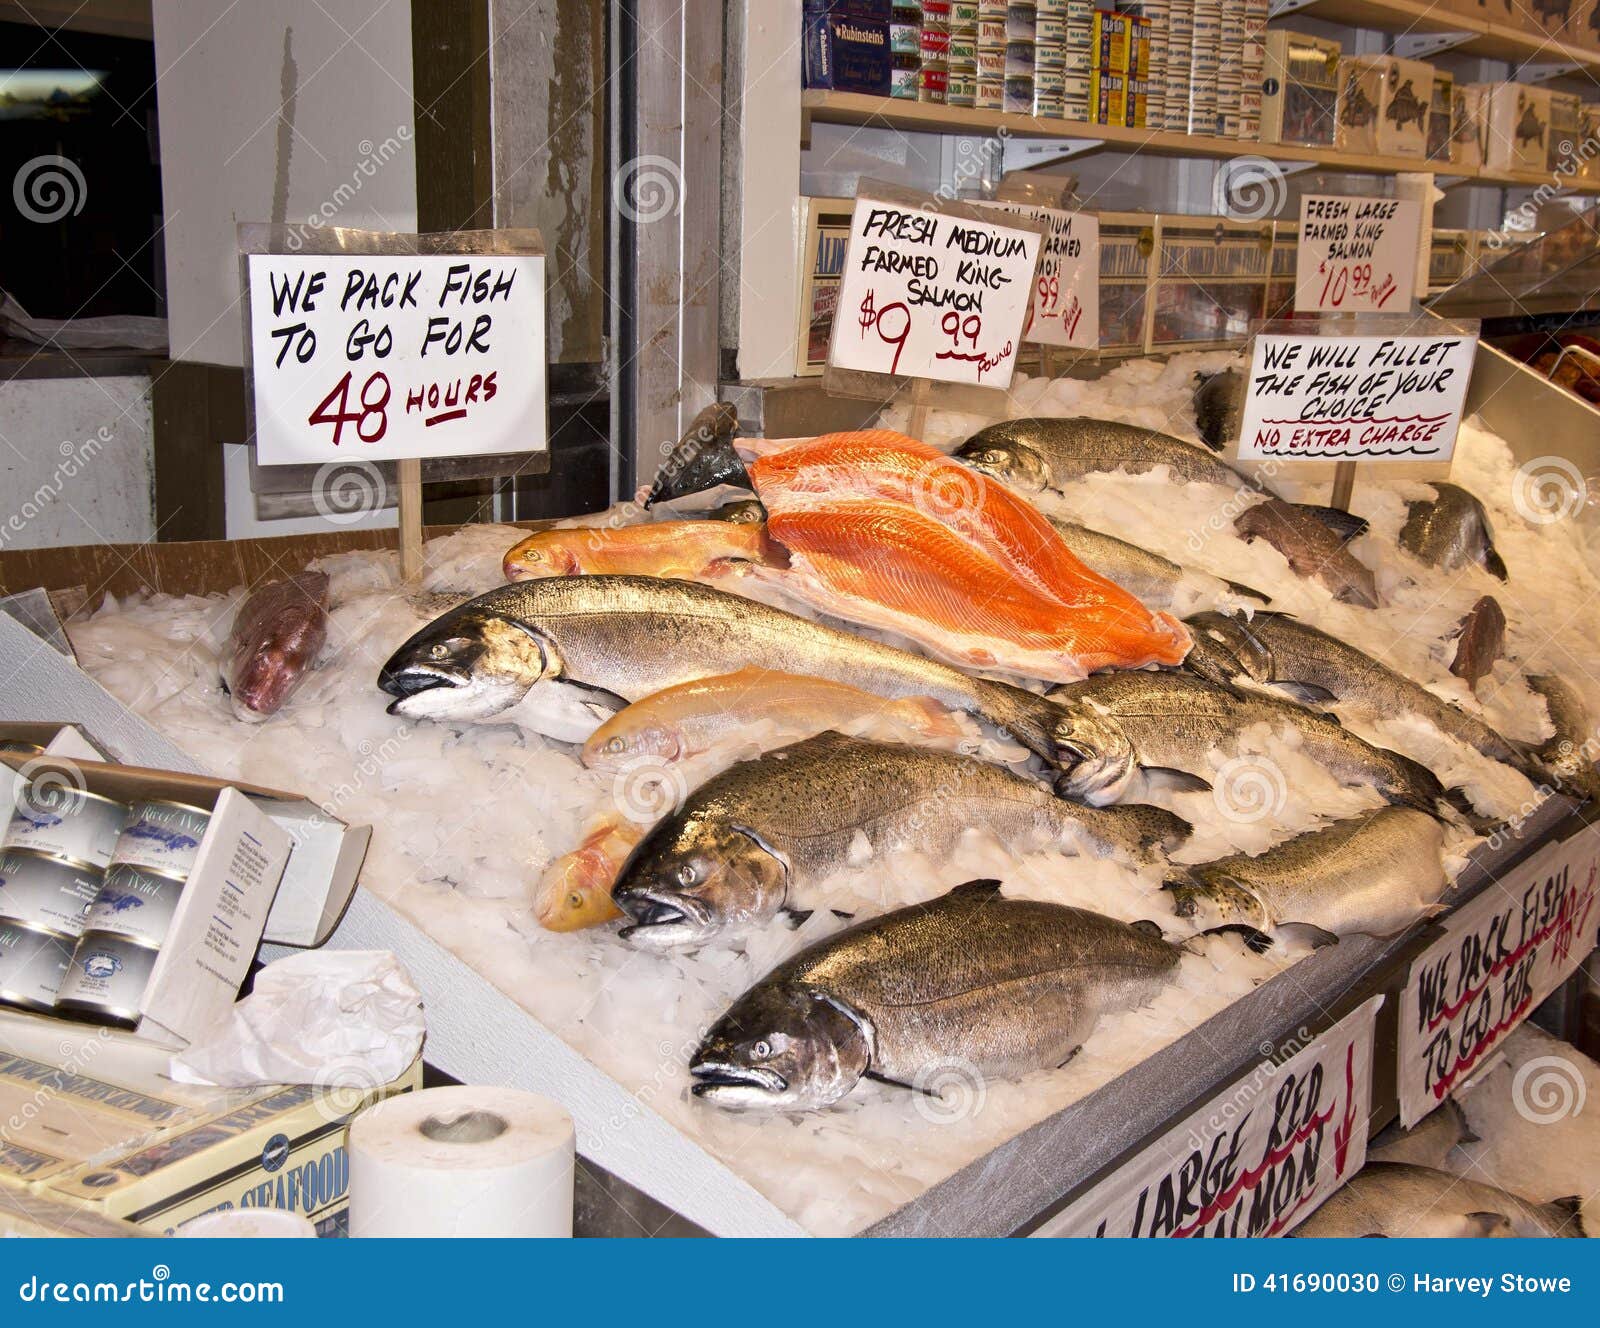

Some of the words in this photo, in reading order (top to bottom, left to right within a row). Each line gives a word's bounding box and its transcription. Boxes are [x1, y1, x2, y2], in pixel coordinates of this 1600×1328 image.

[1306, 199, 1351, 220] FRESH
[1355, 200, 1399, 220] LARGE
[863, 210, 937, 248] FRESH
[947, 225, 1027, 260] MEDIUM
[1304, 223, 1349, 242] FARMED
[1354, 221, 1385, 243] KING
[862, 246, 938, 280] FARMED
[1327, 242, 1375, 260] SALMON
[270, 271, 326, 317] WE
[341, 269, 421, 312] PACK
[439, 264, 517, 308] FISH
[907, 279, 983, 313] SALMON
[271, 322, 317, 369] TO
[346, 319, 393, 361] GO
[421, 314, 492, 359] FOR
[1263, 342, 1302, 370] WE
[1306, 344, 1360, 371] WILL
[1368, 340, 1461, 368] FILLET
[1255, 373, 1303, 397] THE
[1305, 370, 1359, 396] FISH
[1359, 371, 1395, 395] OF
[1386, 368, 1454, 404] YOUR
[308, 371, 391, 446] 48
[406, 371, 498, 414] HOURS
[1300, 393, 1386, 420] CHOICE
[1254, 426, 1281, 450] NO
[1289, 426, 1351, 449] EXTRA
[1358, 421, 1448, 447] CHARGE
[1418, 952, 1452, 1034] WE
[1456, 907, 1513, 1000] PACK
[1520, 863, 1569, 948] FISH
[1422, 1025, 1452, 1094] TO
[1459, 986, 1492, 1058] GO
[1501, 948, 1537, 1024] FOR
[1264, 1062, 1324, 1166] RED
